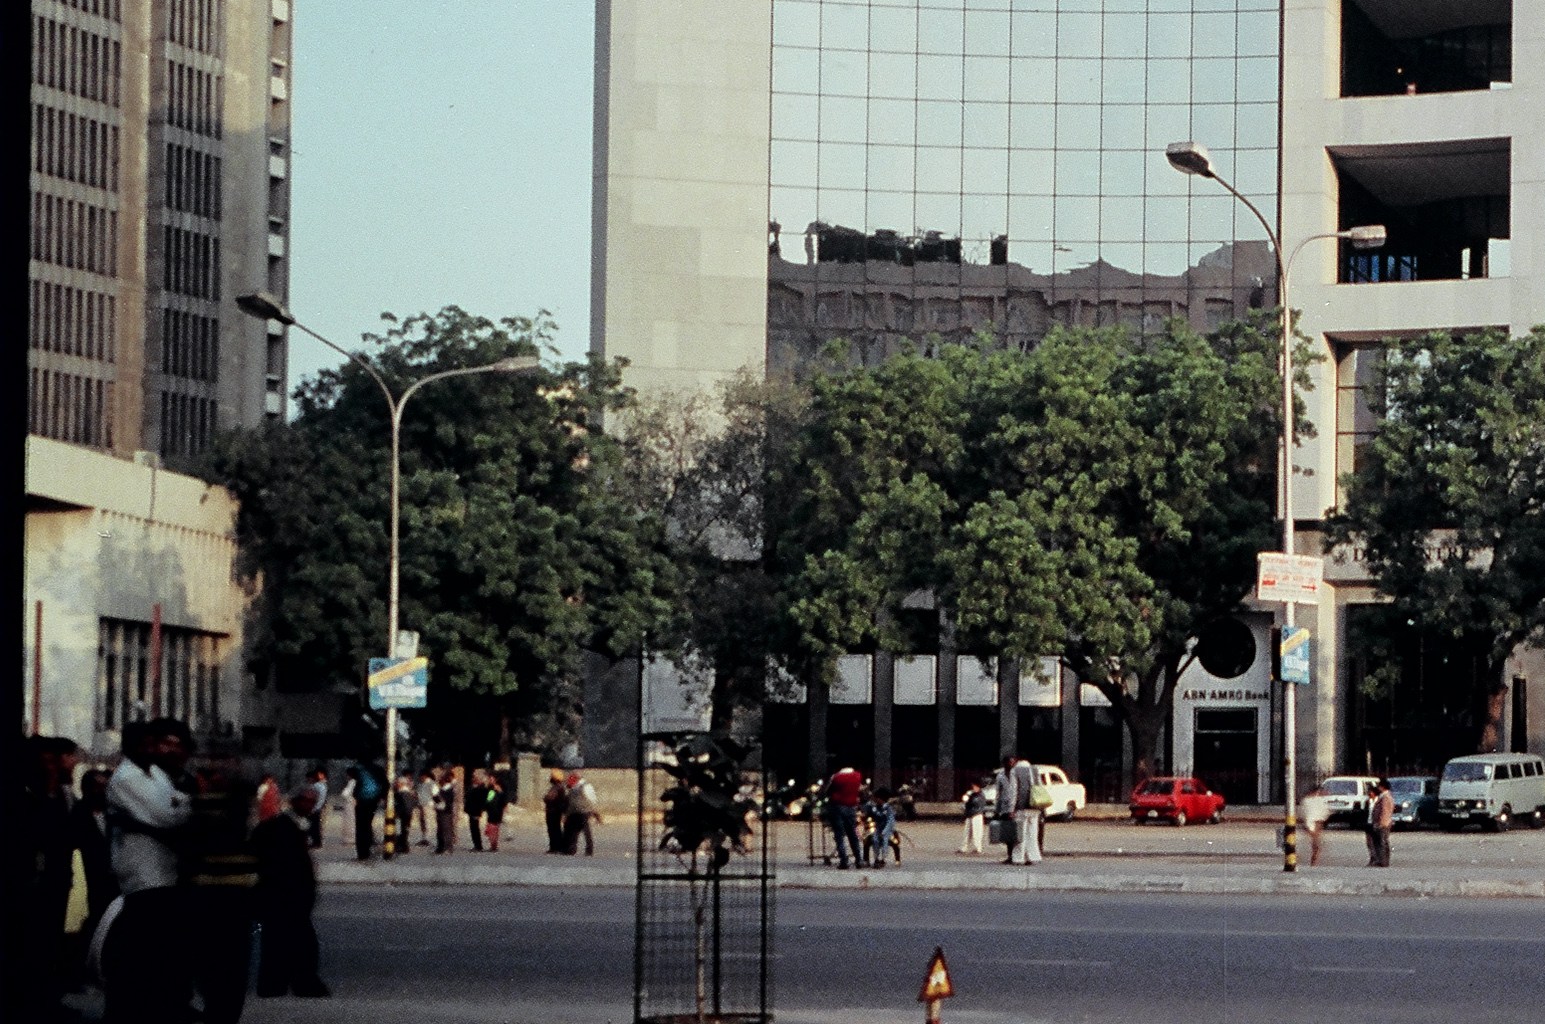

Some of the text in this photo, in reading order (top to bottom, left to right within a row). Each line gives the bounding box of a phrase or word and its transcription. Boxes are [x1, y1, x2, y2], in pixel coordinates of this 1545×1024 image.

[1183, 690, 1269, 700] ABN AMRO Bank
